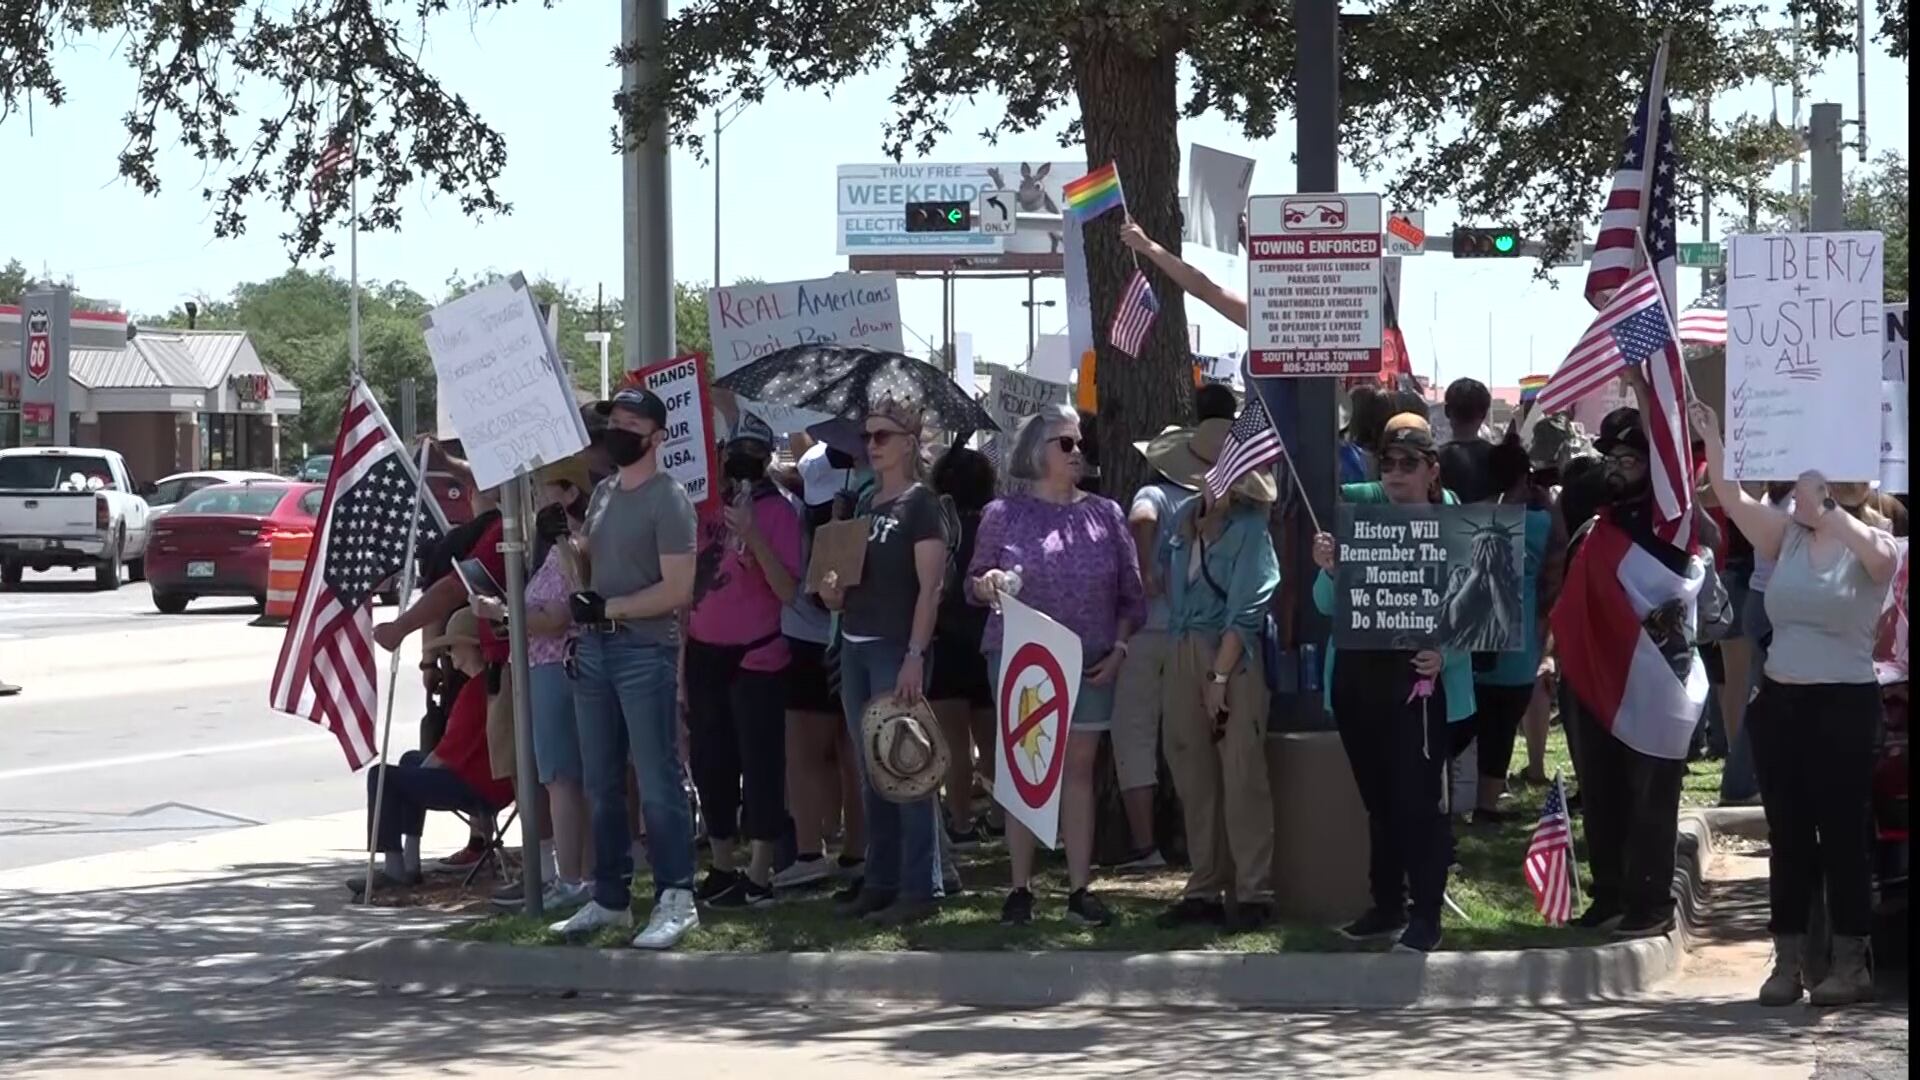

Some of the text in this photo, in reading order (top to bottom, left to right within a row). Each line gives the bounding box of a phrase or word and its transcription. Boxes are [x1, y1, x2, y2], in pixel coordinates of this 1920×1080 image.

[880, 166, 963, 178] TRULY FREE
[845, 218, 907, 232] ELECTR
[984, 222, 1011, 232] ONLY
[1253, 239, 1377, 255] TOWING ENFORCED
[1258, 262, 1370, 273] STAYBRIDGE SUITES LUBBOCK
[1732, 236, 1876, 283] LIBERTY
[1287, 275, 1342, 284] PARKING ONLY
[1253, 286, 1377, 297] ALL OTHER VEHICLES PROHIBITED
[1267, 298, 1362, 308] UNAUTHORIZED VEHICLES
[1261, 310, 1369, 320] WILL BE TOWED AT OWNER'S
[1733, 298, 1881, 347] JUSTICE
[1268, 322, 1362, 332] OR OPERATOR'S EXPENSE
[1270, 334, 1361, 344] AT ALL TIMES AND DAYS
[30, 340, 46, 367] 66
[1261, 350, 1370, 362] SOUTH PLAINS TOWING
[1775, 342, 1819, 371] ALL
[648, 362, 696, 389] HANDS
[666, 390, 692, 411] OFF
[663, 422, 690, 442] OUR
[663, 450, 696, 469] USA,
[1353, 520, 1440, 543] History Will
[1340, 543, 1447, 562] Remember The
[1365, 566, 1425, 584] Moment
[1350, 588, 1440, 606] We Chose To
[1351, 610, 1438, 634] Do Nothing.
